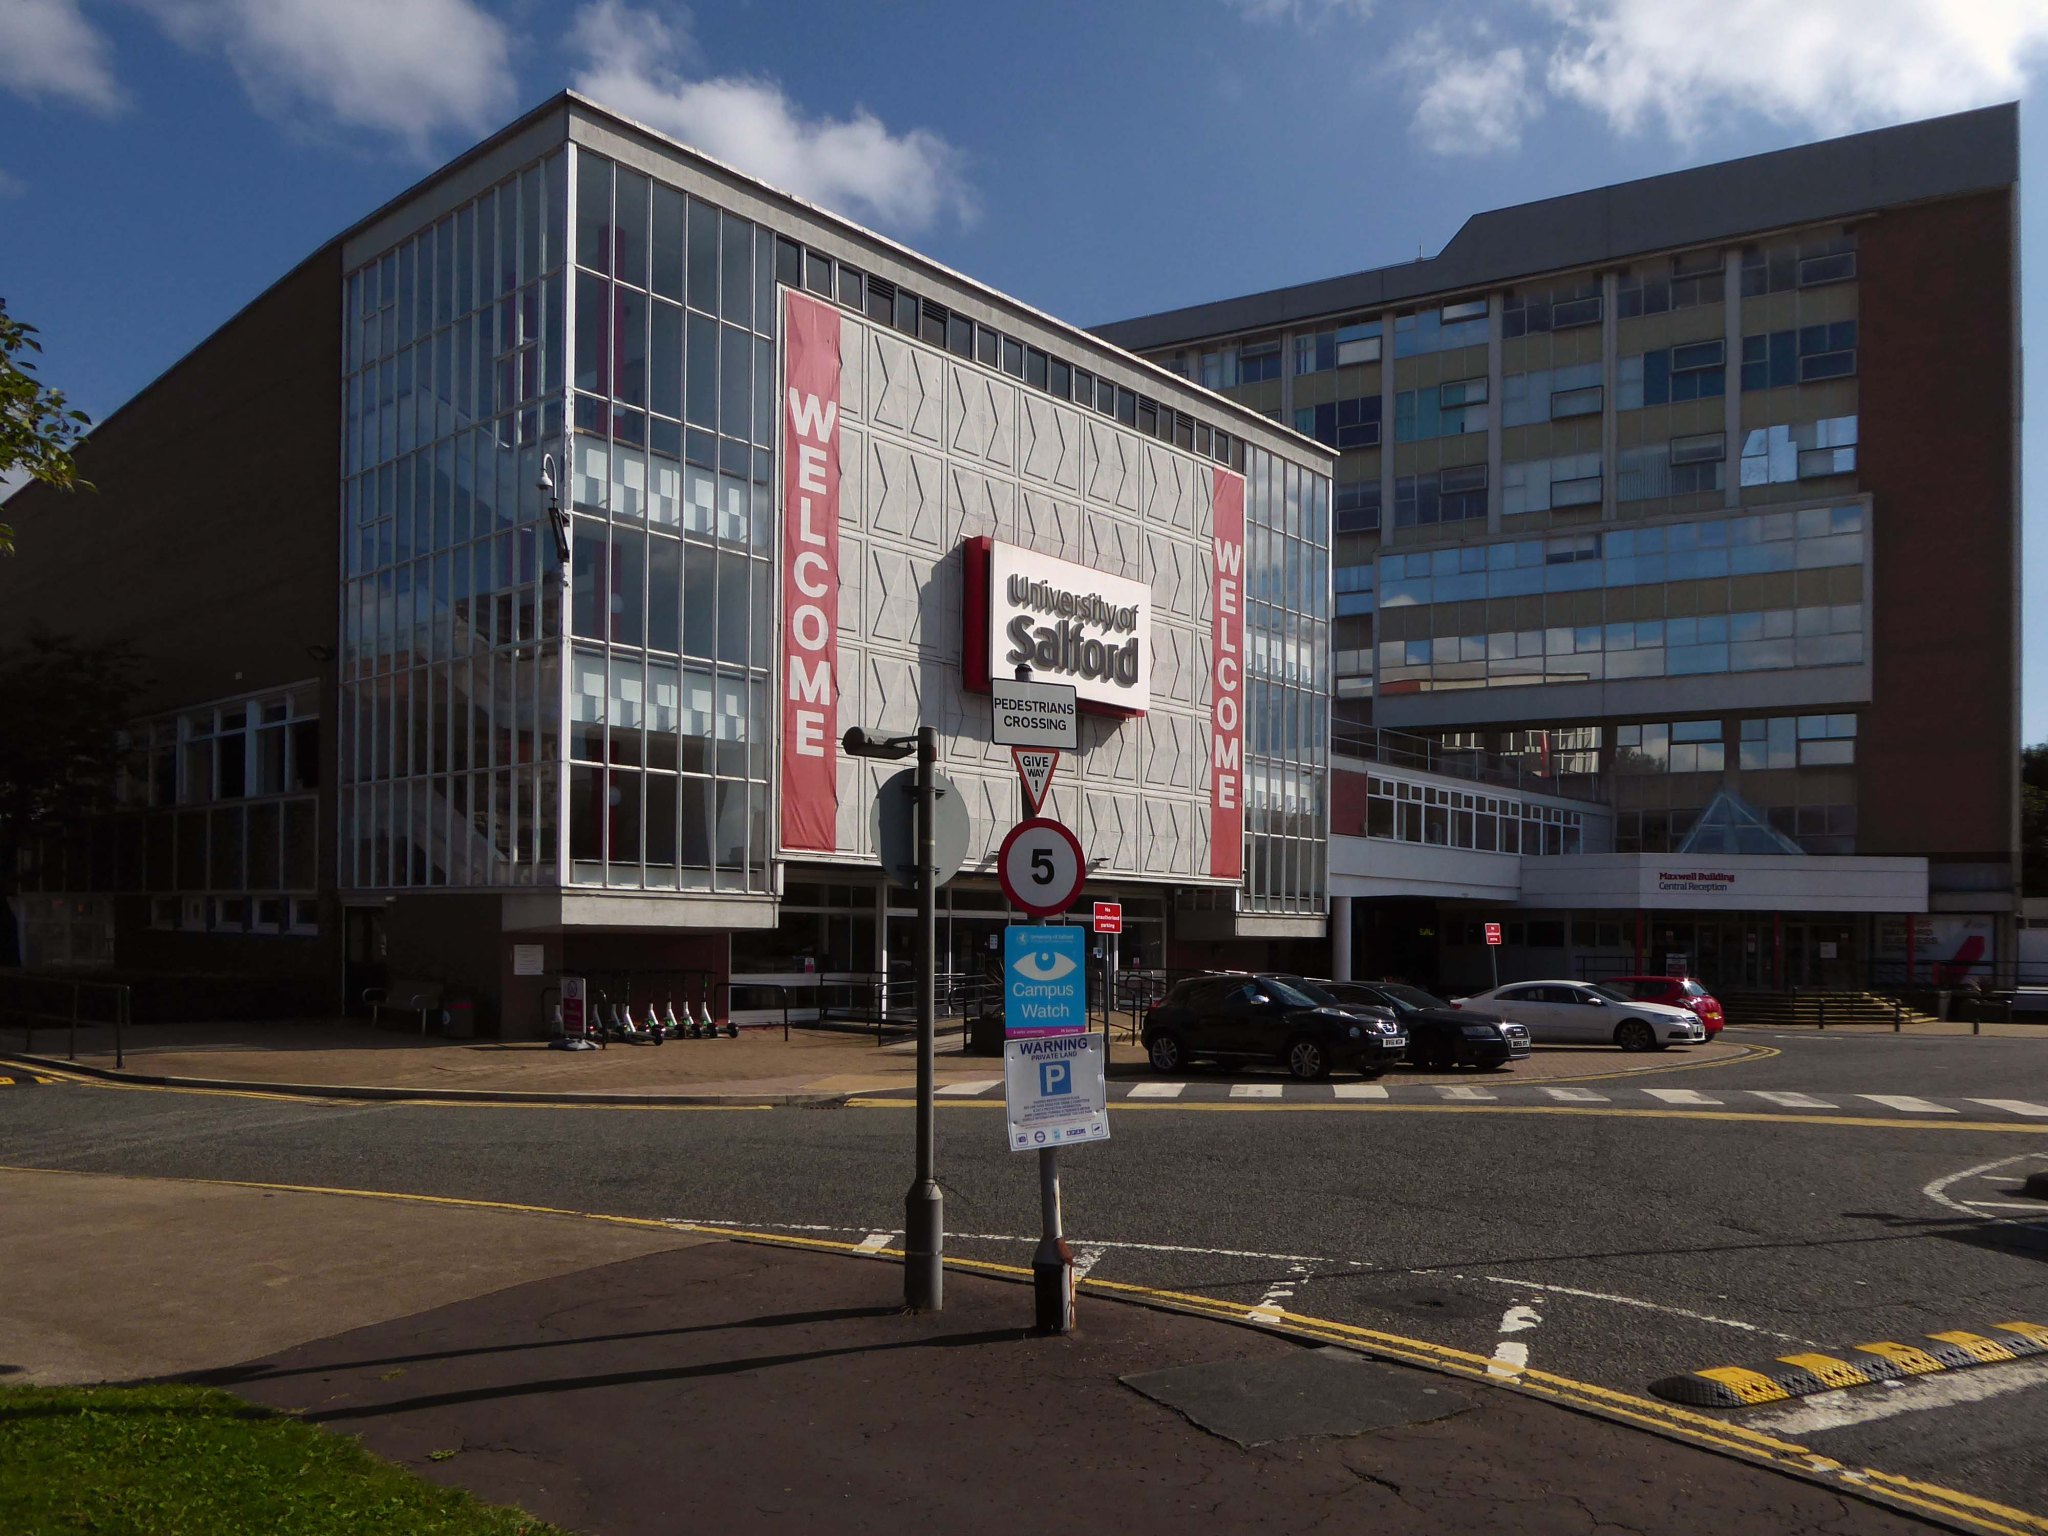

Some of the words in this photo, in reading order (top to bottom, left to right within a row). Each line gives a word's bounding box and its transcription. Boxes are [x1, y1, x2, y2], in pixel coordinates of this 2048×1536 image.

[789, 386, 837, 758] WELCOME
[1007, 573, 1117, 636] University
[1114, 604, 1139, 635] of
[1006, 614, 1139, 688] Salford
[1214, 537, 1241, 809] WELCOME
[994, 697, 1075, 715] PEDESTRIANS
[1003, 715, 1067, 731] CROSSING
[1022, 755, 1049, 768] GIVE
[1026, 768, 1046, 778] WAY
[1031, 848, 1055, 885] 5
[1659, 872, 1697, 881] Maxwell
[1698, 872, 1735, 883] Building
[1659, 881, 1687, 890] Central
[1688, 882, 1728, 892] Reception
[1012, 982, 1074, 999] Campus
[1021, 1003, 1069, 1018] Watch
[1020, 1037, 1088, 1055] WARNING
[1031, 1053, 1059, 1061] PRIVATE
[1046, 1063, 1066, 1093] P
